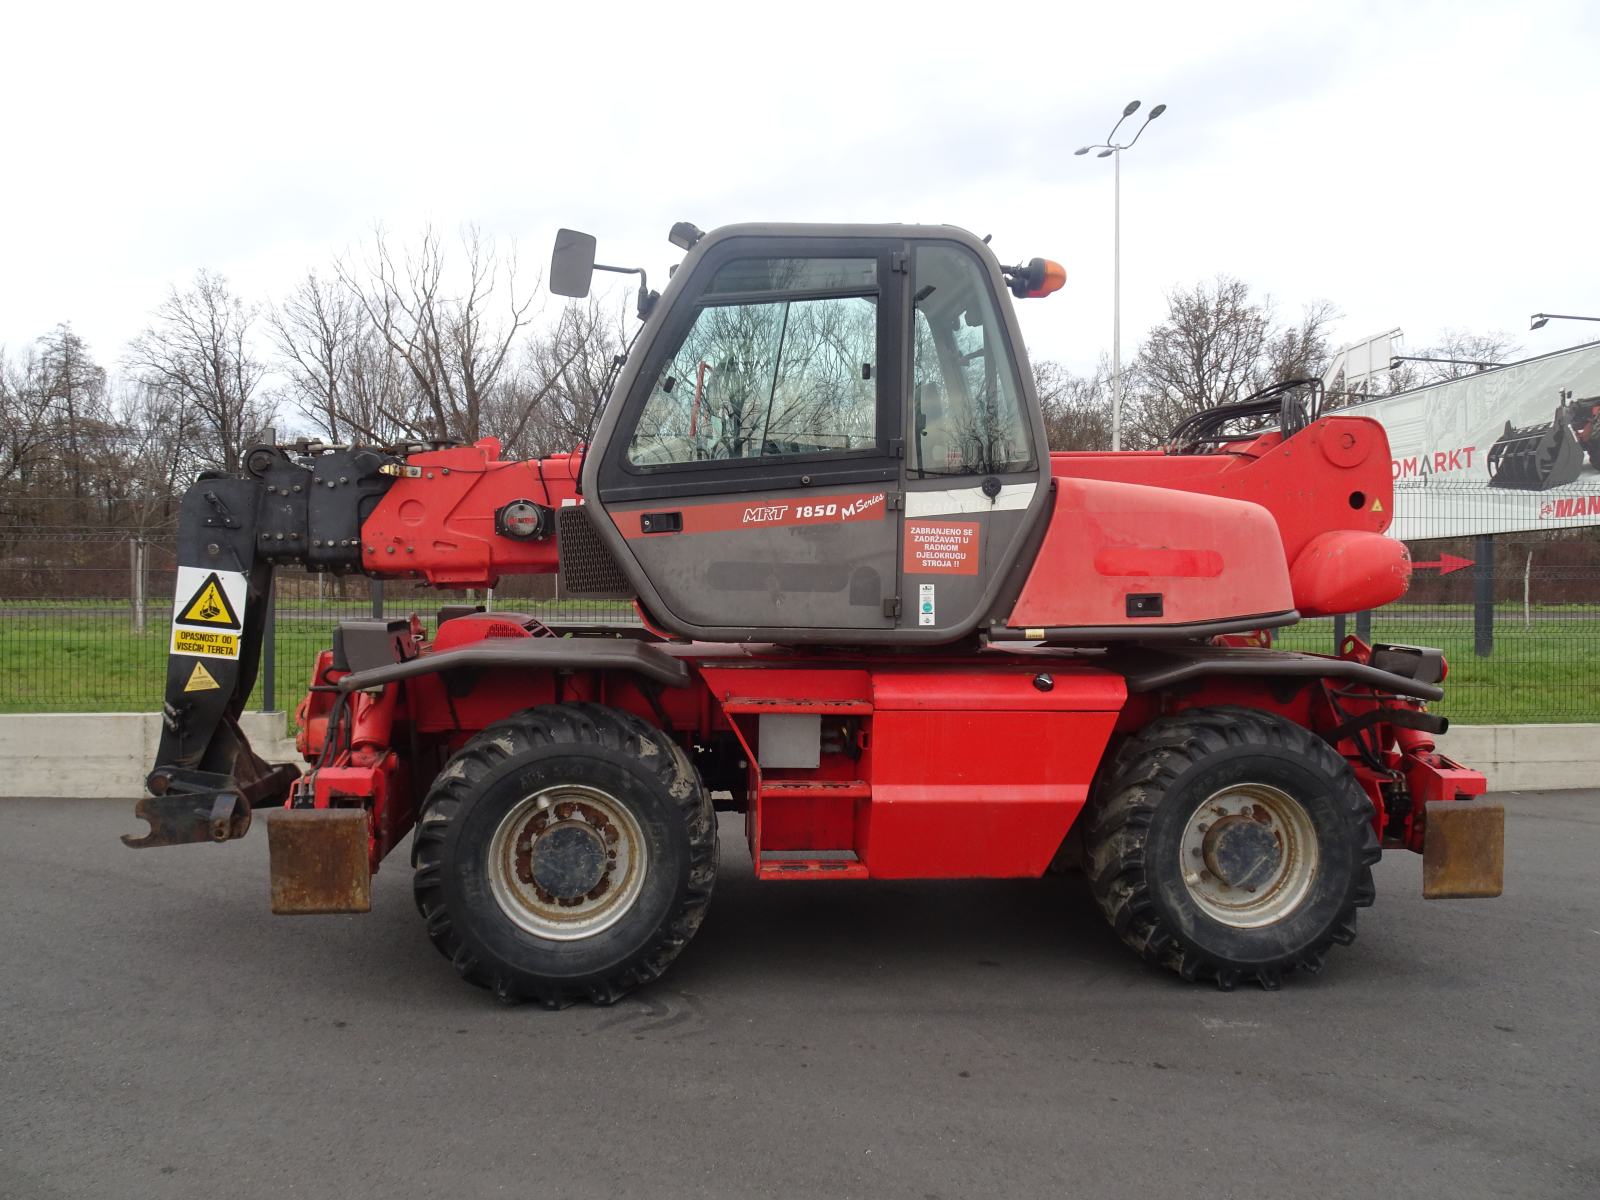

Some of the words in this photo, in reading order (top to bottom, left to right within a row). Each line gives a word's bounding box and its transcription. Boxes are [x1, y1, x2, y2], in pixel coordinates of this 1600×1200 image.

[743, 506, 788, 522] MRT
[795, 504, 837, 518] 1850
[841, 504, 857, 521] M
[856, 493, 885, 513] Series
[910, 527, 962, 536] ZABRANJENO
[963, 528, 973, 536] SE
[914, 535, 961, 544] ZADRŽAVATI
[924, 543, 959, 551] RADNOM
[916, 551, 966, 560] DJELOKRUGU
[922, 560, 952, 568] STROJA
[180, 631, 219, 643] OPASNOST
[221, 635, 232, 645] OD
[207, 644, 234, 656] TERETA
